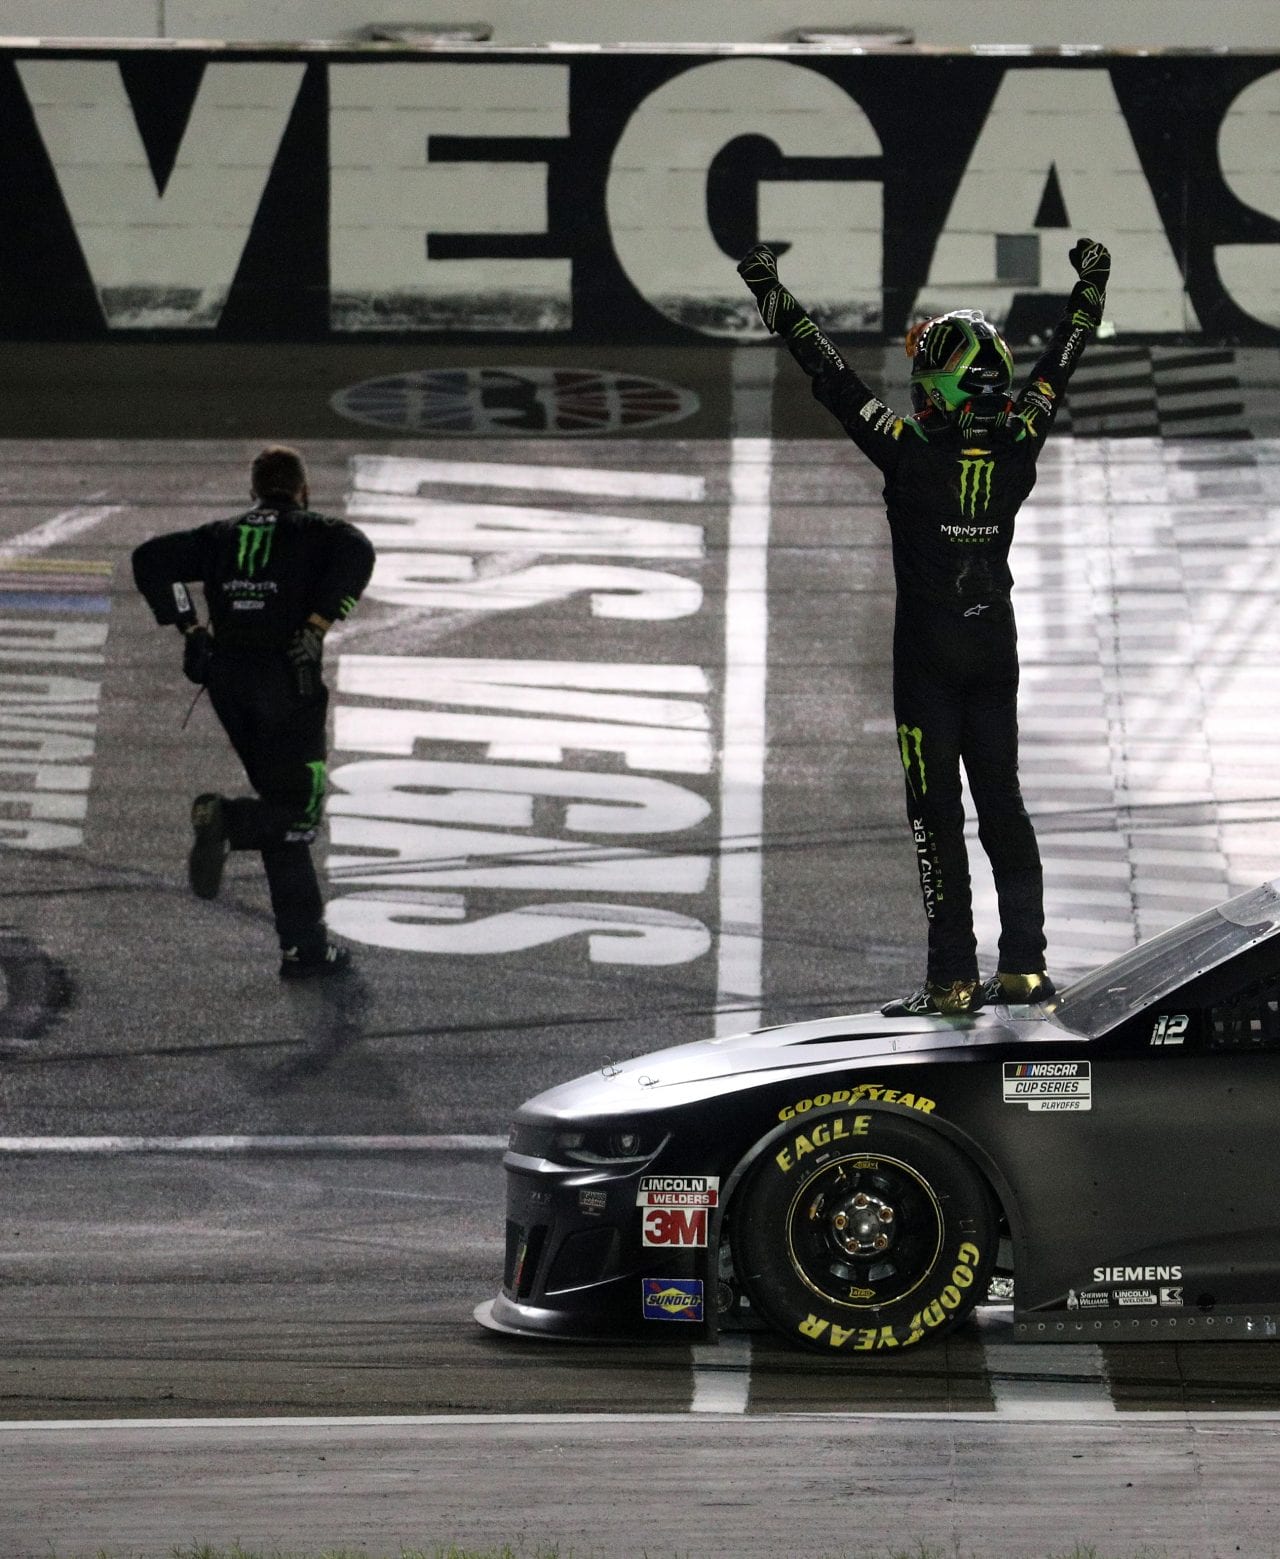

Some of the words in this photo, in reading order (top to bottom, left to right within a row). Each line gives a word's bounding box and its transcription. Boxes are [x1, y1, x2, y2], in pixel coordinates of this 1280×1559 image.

[940, 524, 1000, 536] MONSTER
[325, 654, 715, 966] VEGAS
[1031, 1064, 1078, 1076] NASCAR
[1015, 1081, 1038, 1093] CUP
[1039, 1081, 1079, 1093] SERIES
[778, 1084, 937, 1121] GOODYEAR
[1041, 1101, 1080, 1110] PLAYOFFS
[775, 1115, 873, 1173] EAGLE
[640, 1178, 705, 1192] LINCOLN
[653, 1193, 710, 1205] WELDERS
[644, 1209, 706, 1245] 3M
[1093, 1265, 1183, 1282] SIEMENS
[647, 1294, 699, 1306] SUNOCO
[1114, 1290, 1149, 1298] LINCOLN
